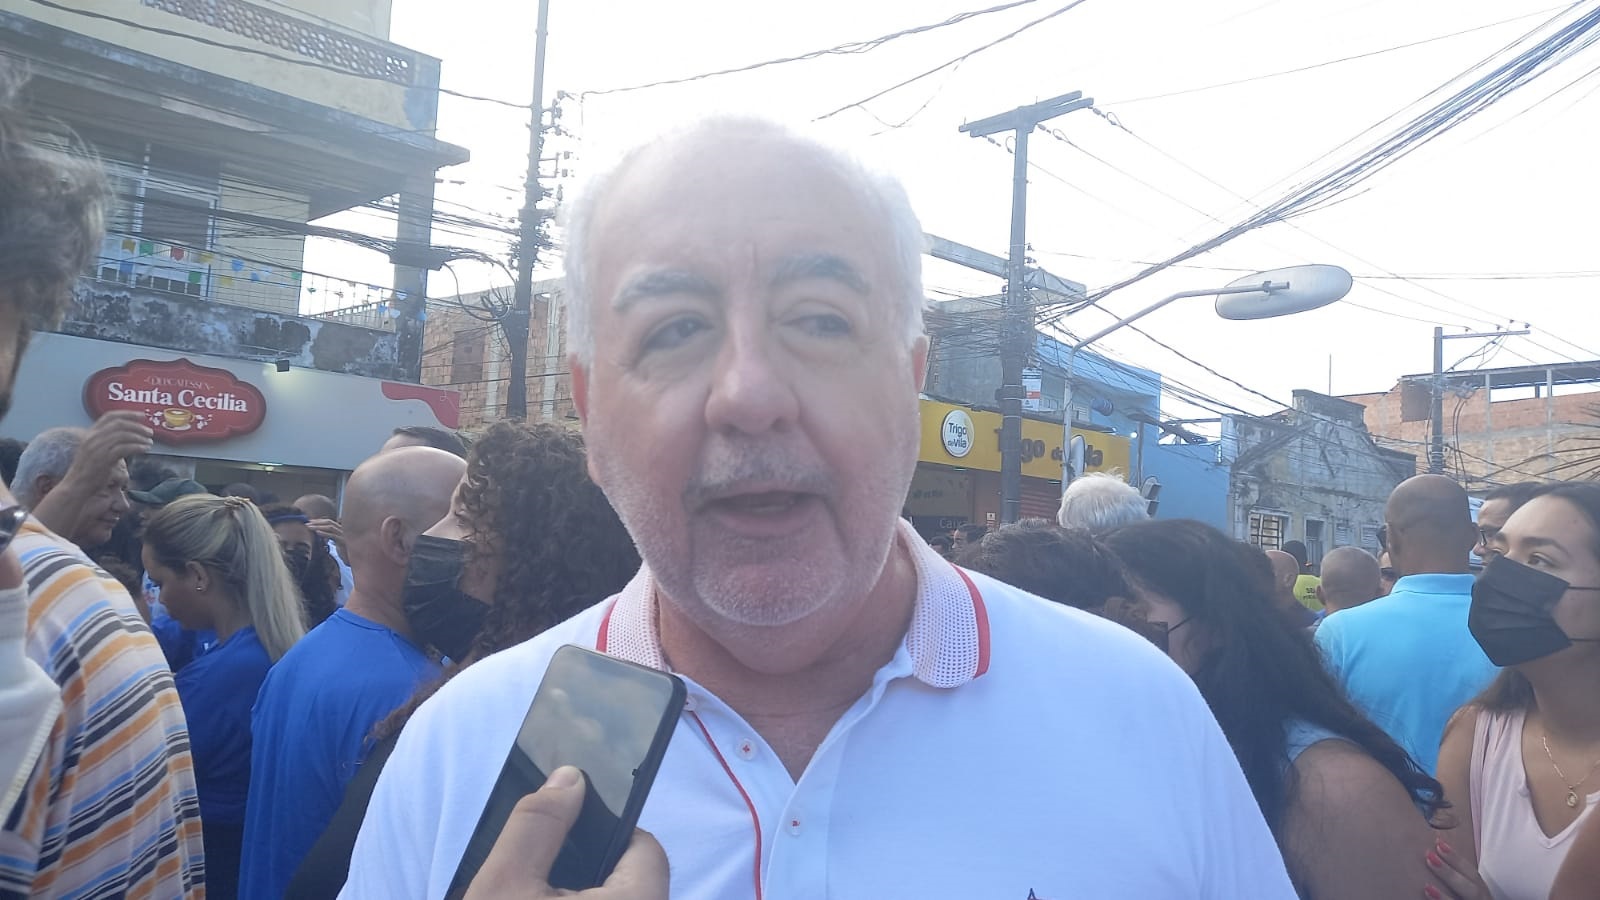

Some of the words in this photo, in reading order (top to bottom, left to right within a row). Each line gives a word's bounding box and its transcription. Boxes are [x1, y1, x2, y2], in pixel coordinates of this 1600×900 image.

[108, 382, 174, 406] Santa
[177, 389, 248, 412] Cecilia
[948, 422, 967, 437] Trigo
[953, 438, 967, 448] Vila
